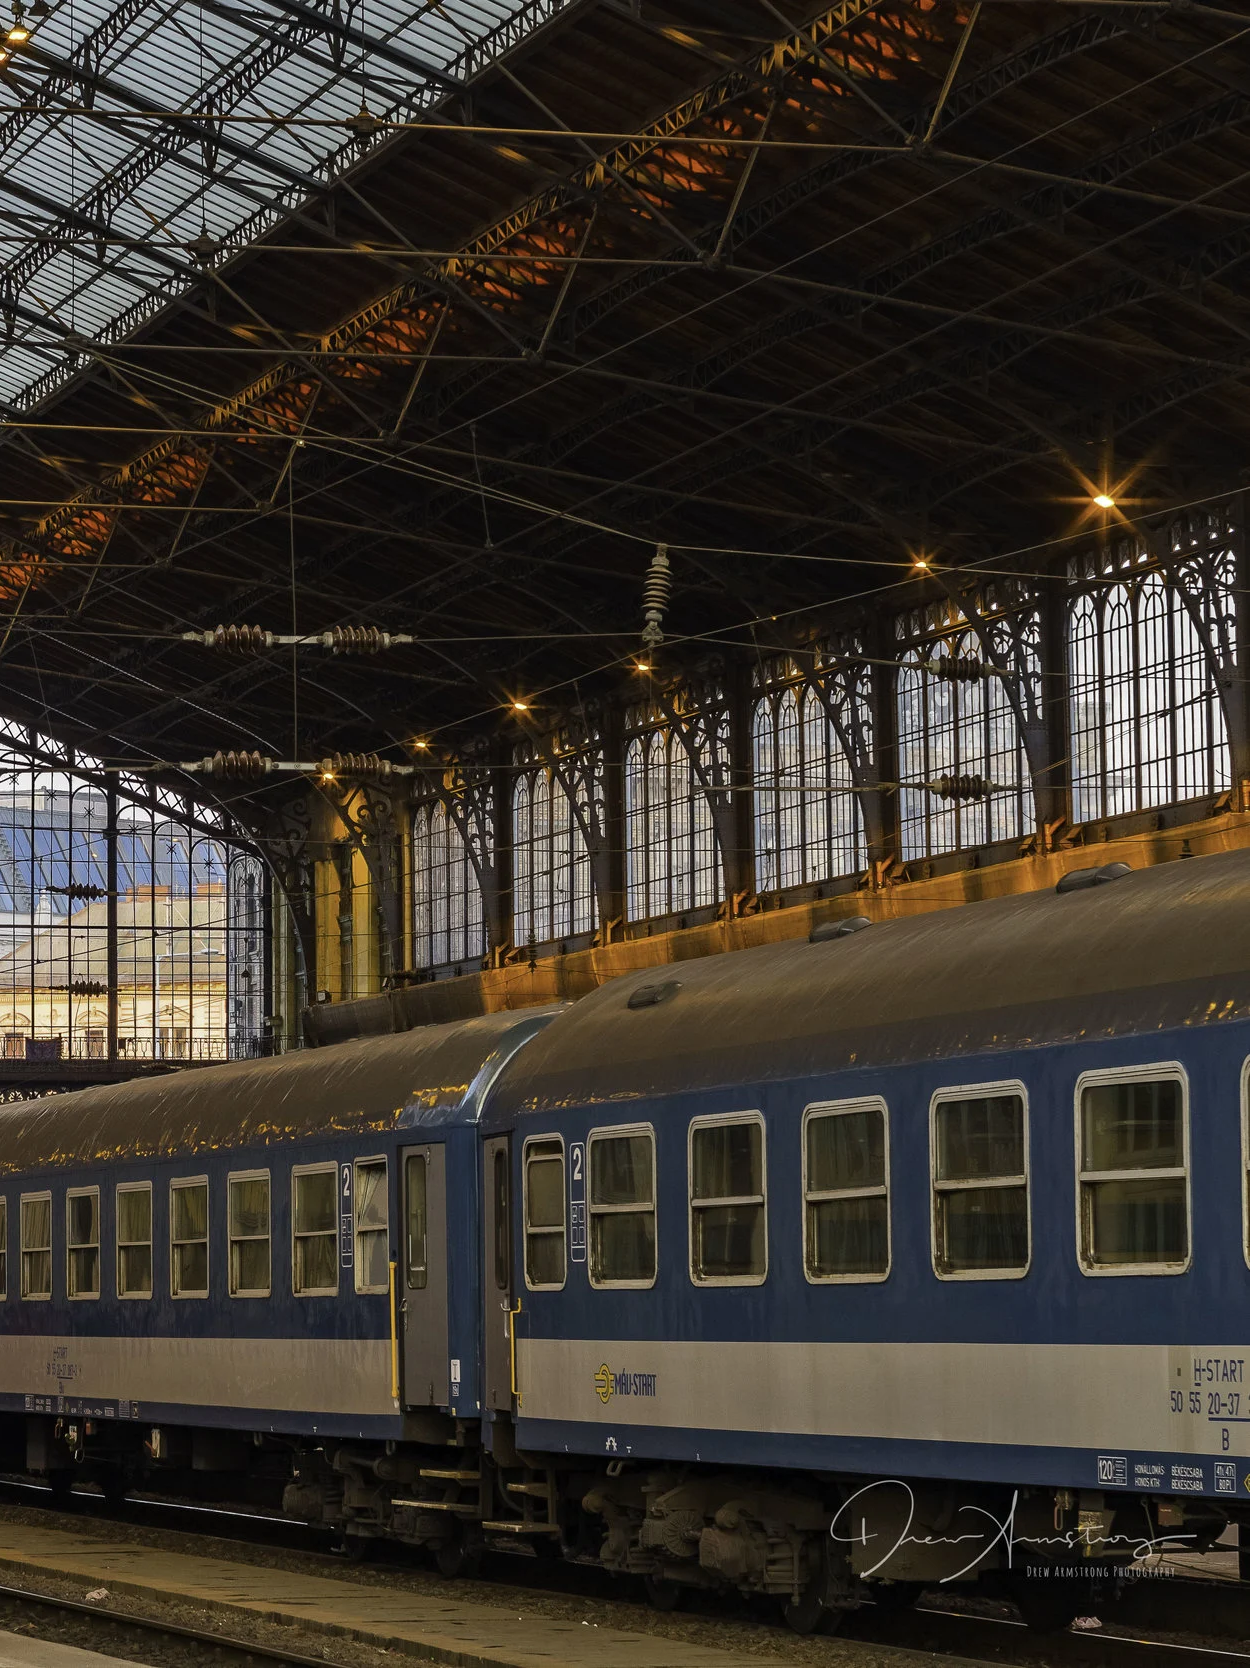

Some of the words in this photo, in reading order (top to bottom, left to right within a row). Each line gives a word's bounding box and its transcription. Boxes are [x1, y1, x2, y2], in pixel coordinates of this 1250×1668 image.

[573, 1147, 582, 1180] 2
[343, 1168, 350, 1196] 2
[1193, 1358, 1245, 1384] H-START
[1170, 1390, 1183, 1413] 50
[1189, 1391, 1201, 1414] 55
[1208, 1392, 1240, 1415] 20-37
[1222, 1428, 1230, 1451] B
[1099, 1460, 1113, 1480] 120
[1171, 1464, 1203, 1478] BÉKÉSCSABA
